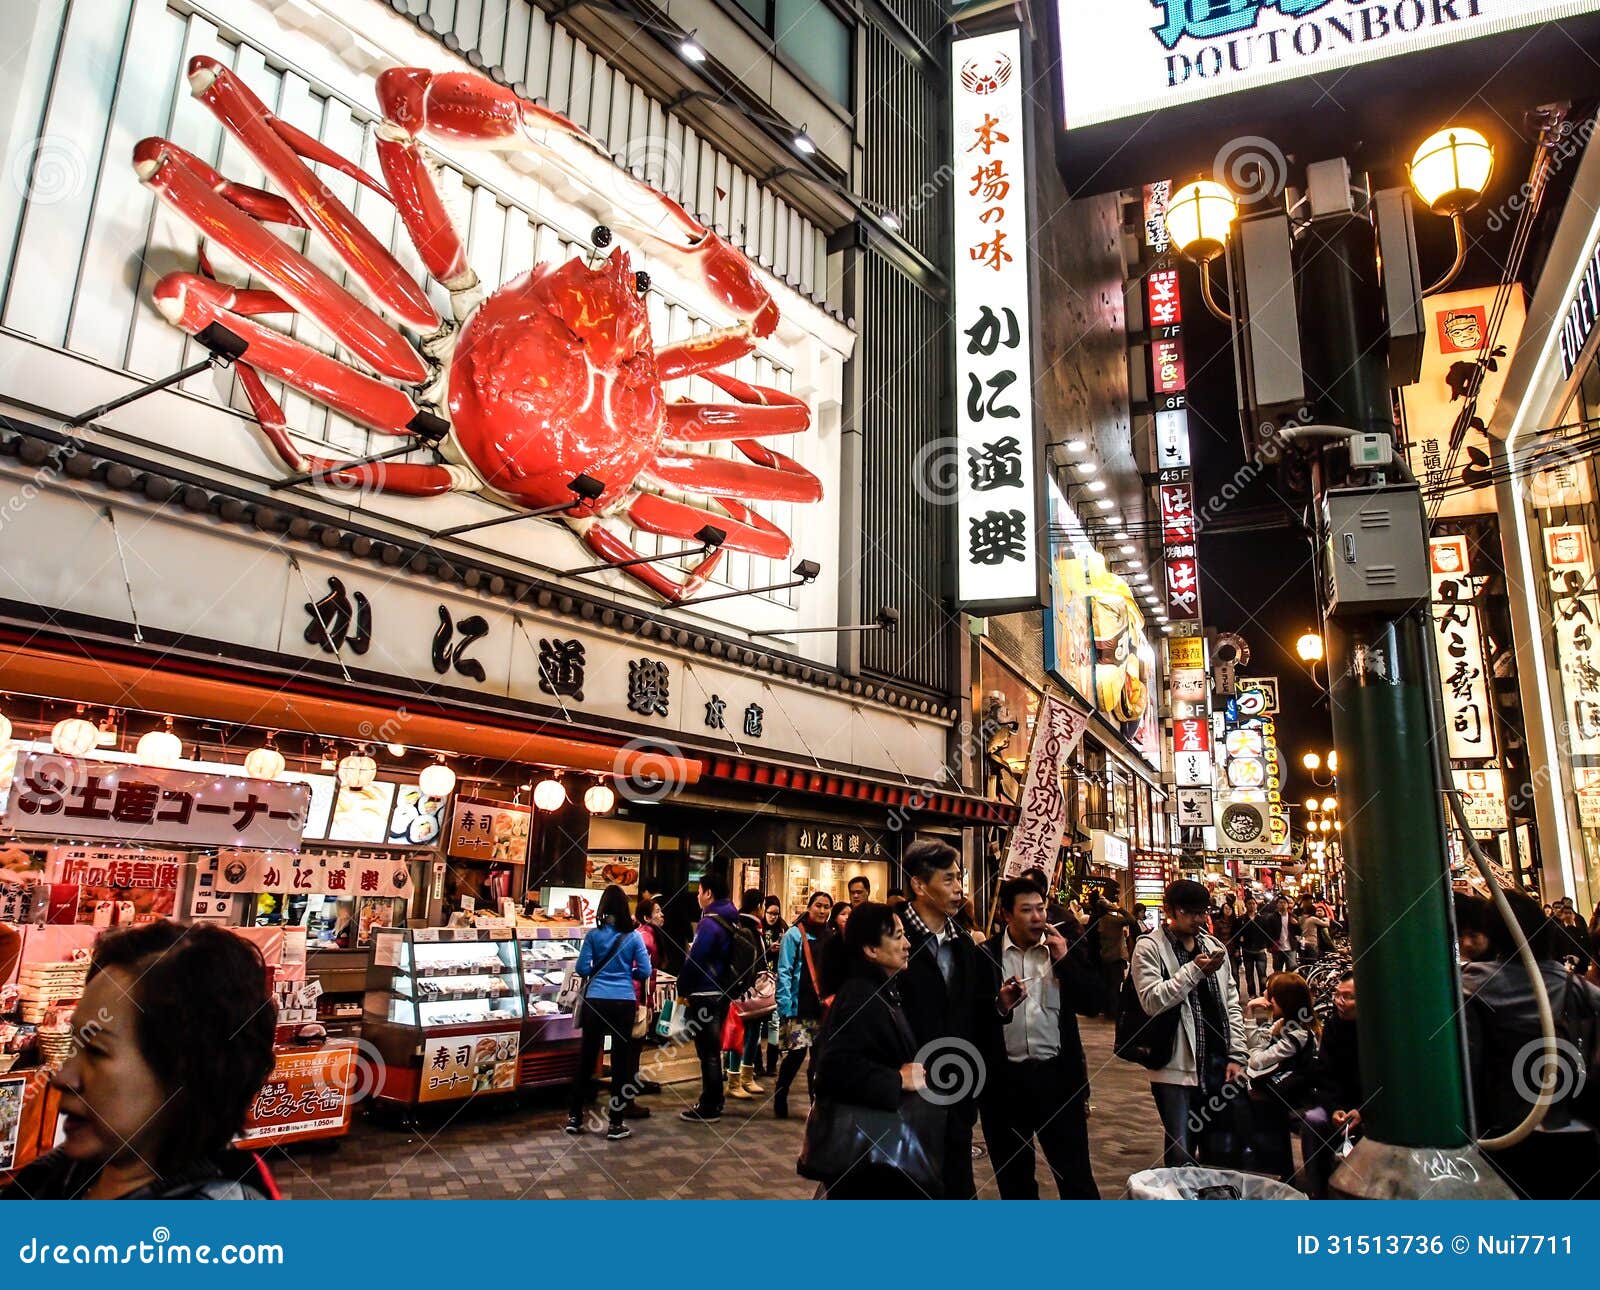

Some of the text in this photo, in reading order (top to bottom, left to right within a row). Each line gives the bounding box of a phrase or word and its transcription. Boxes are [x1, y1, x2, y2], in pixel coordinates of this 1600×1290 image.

[1165, 0, 1483, 87] DOUTONBORI
[966, 113, 1013, 272] 本場の味
[1559, 241, 1600, 381] FOREV
[1162, 326, 1180, 338] 7F
[1166, 397, 1185, 408] 6F
[964, 305, 1026, 565] かに道楽
[1166, 545, 1194, 558] 焼肉
[1167, 563, 1197, 614] はや
[304, 575, 763, 738] かに道楽 本店
[1185, 704, 1204, 717] 2F
[1181, 719, 1203, 751] 白木屋
[18, 771, 299, 832] お土産コーナー
[461, 810, 492, 834] 寿司
[458, 836, 490, 847] コーナー
[61, 859, 179, 888] 味の特急便
[263, 866, 379, 891] かに道楽
[432, 1045, 472, 1071] 寿司
[261, 1083, 286, 1097] 絶品
[429, 1075, 469, 1089] コーナー
[250, 1087, 344, 1119] にみそ缶
